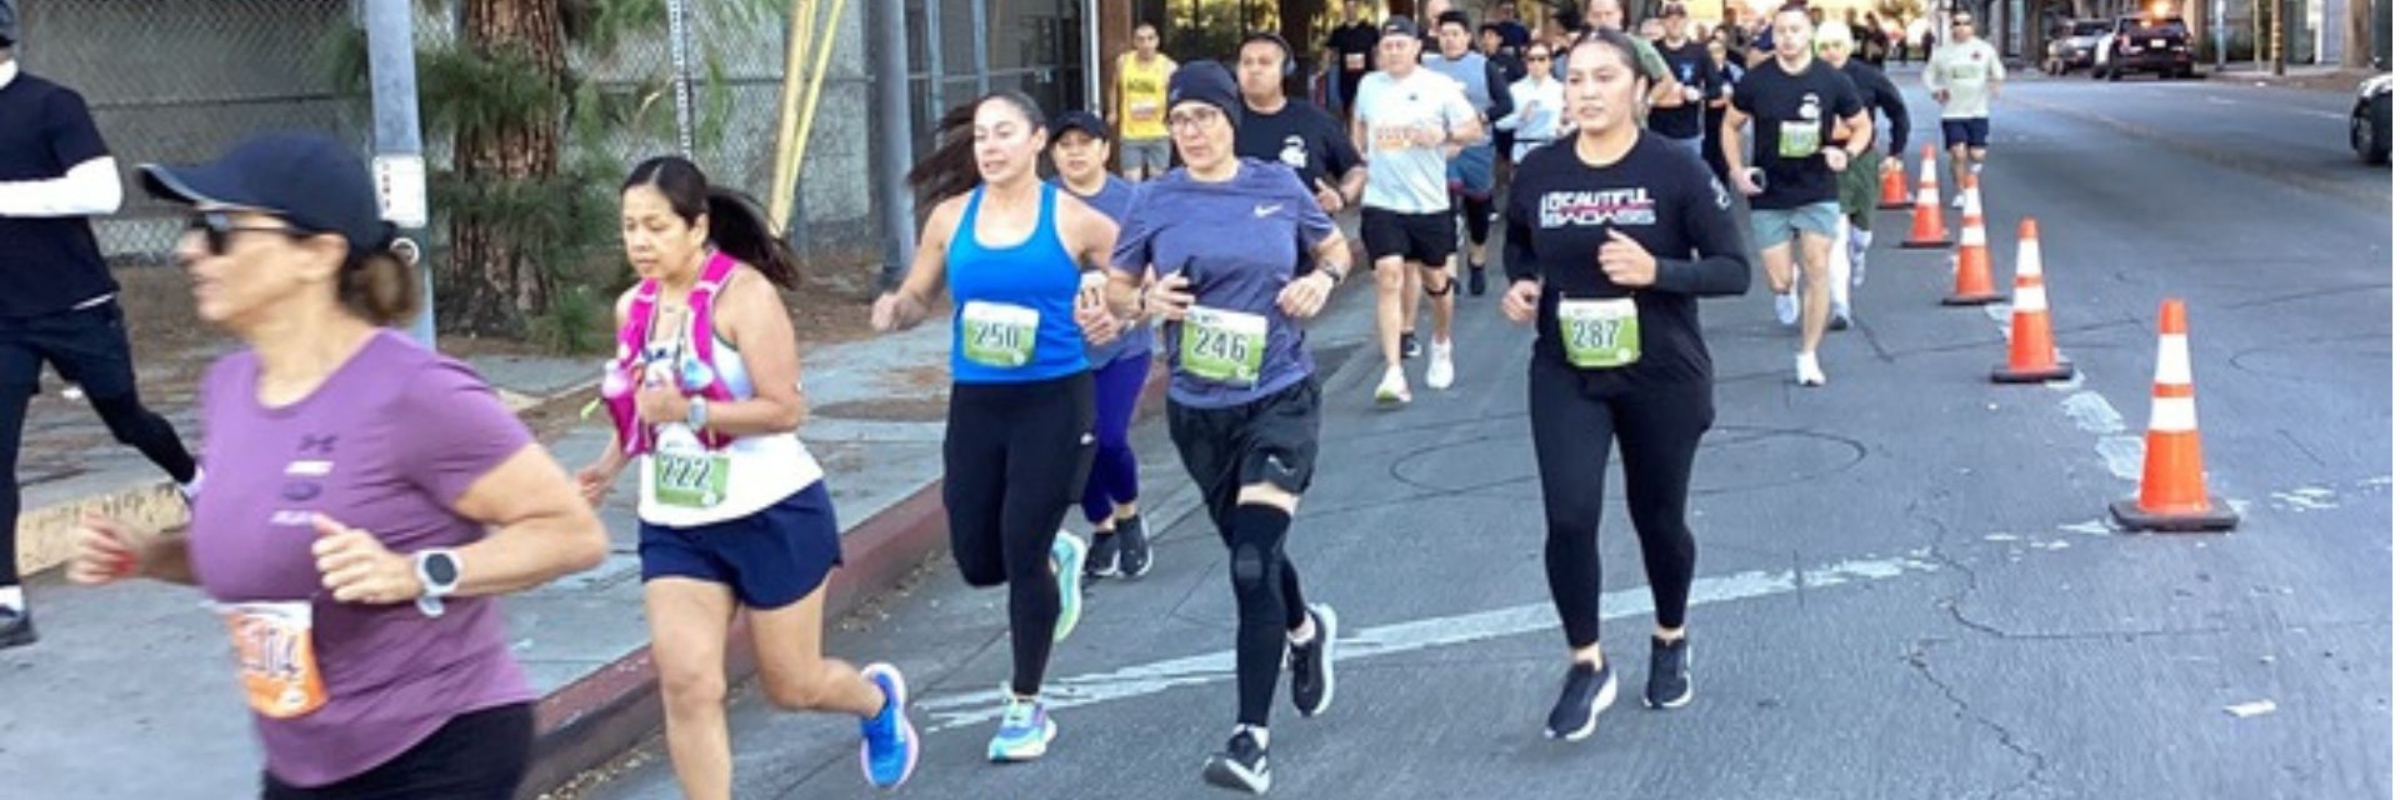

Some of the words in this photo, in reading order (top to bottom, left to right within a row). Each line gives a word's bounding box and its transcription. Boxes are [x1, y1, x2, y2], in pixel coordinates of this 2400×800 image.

[973, 322, 1019, 349] 250
[1193, 326, 1247, 362] 246
[1572, 319, 1619, 348] 287
[662, 453, 712, 488] 222
